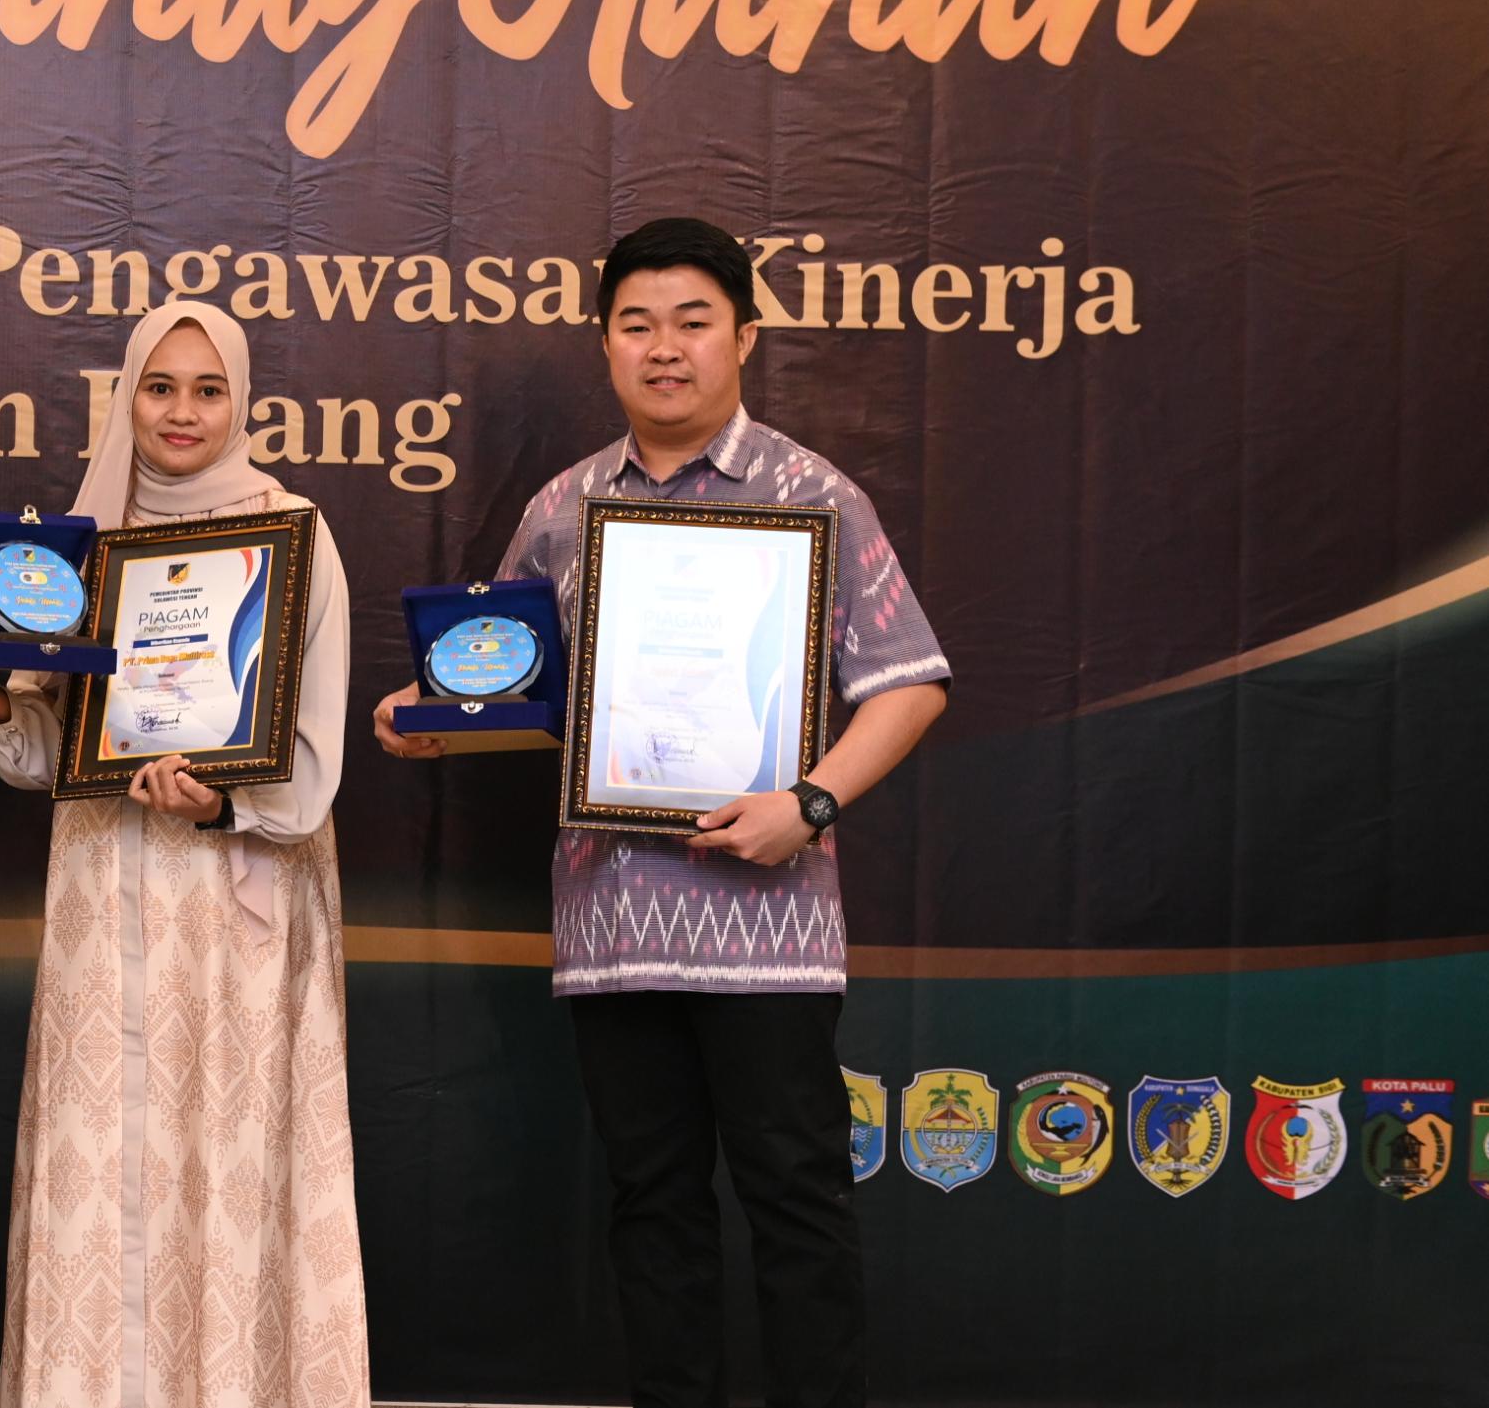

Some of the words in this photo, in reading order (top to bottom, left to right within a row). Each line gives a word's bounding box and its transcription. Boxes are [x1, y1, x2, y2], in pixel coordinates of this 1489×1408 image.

[138, 606, 209, 626] PIAGAM
[1258, 1080, 1315, 1097] KABUPATEN
[1372, 1081, 1409, 1091] KOTA
[1411, 1081, 1447, 1092] PALU
